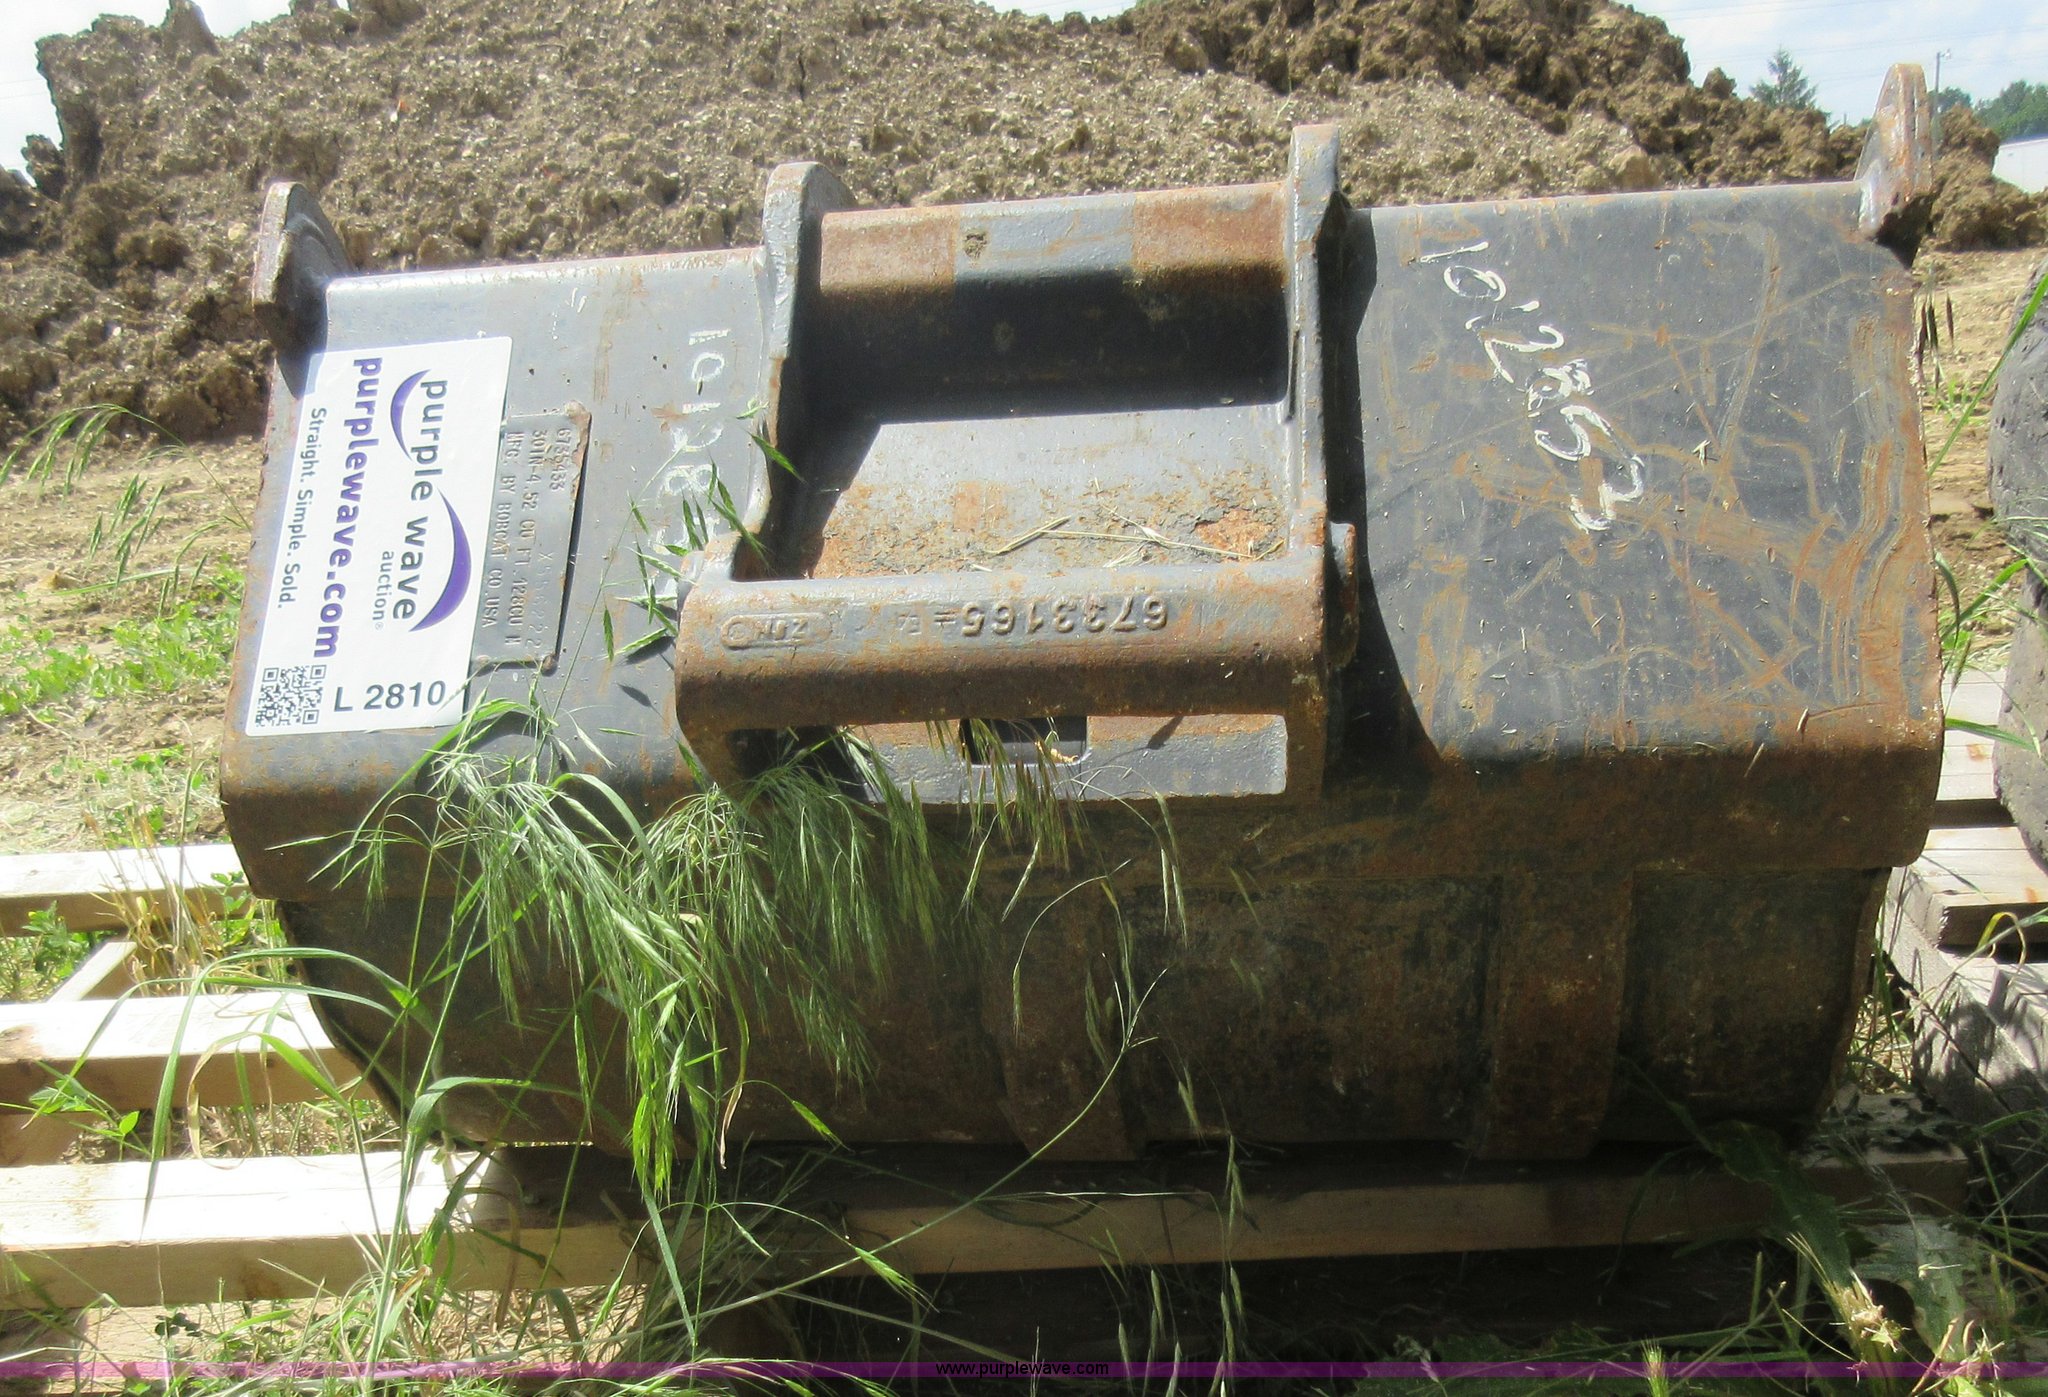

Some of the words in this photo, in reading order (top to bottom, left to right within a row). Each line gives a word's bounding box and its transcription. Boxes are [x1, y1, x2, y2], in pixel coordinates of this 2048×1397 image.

[299, 407, 327, 483] Straight.
[410, 380, 448, 501] purple
[313, 357, 383, 658] purplewave.com
[499, 475, 517, 495] BY
[287, 489, 314, 557] Simple.
[490, 502, 513, 559] BOBCAT
[519, 518, 535, 539] CU
[277, 563, 301, 609] Sold.
[393, 516, 429, 620] wave
[960, 594, 1168, 638] 6733165
[334, 686, 353, 712] L
[363, 680, 446, 710] 2810
